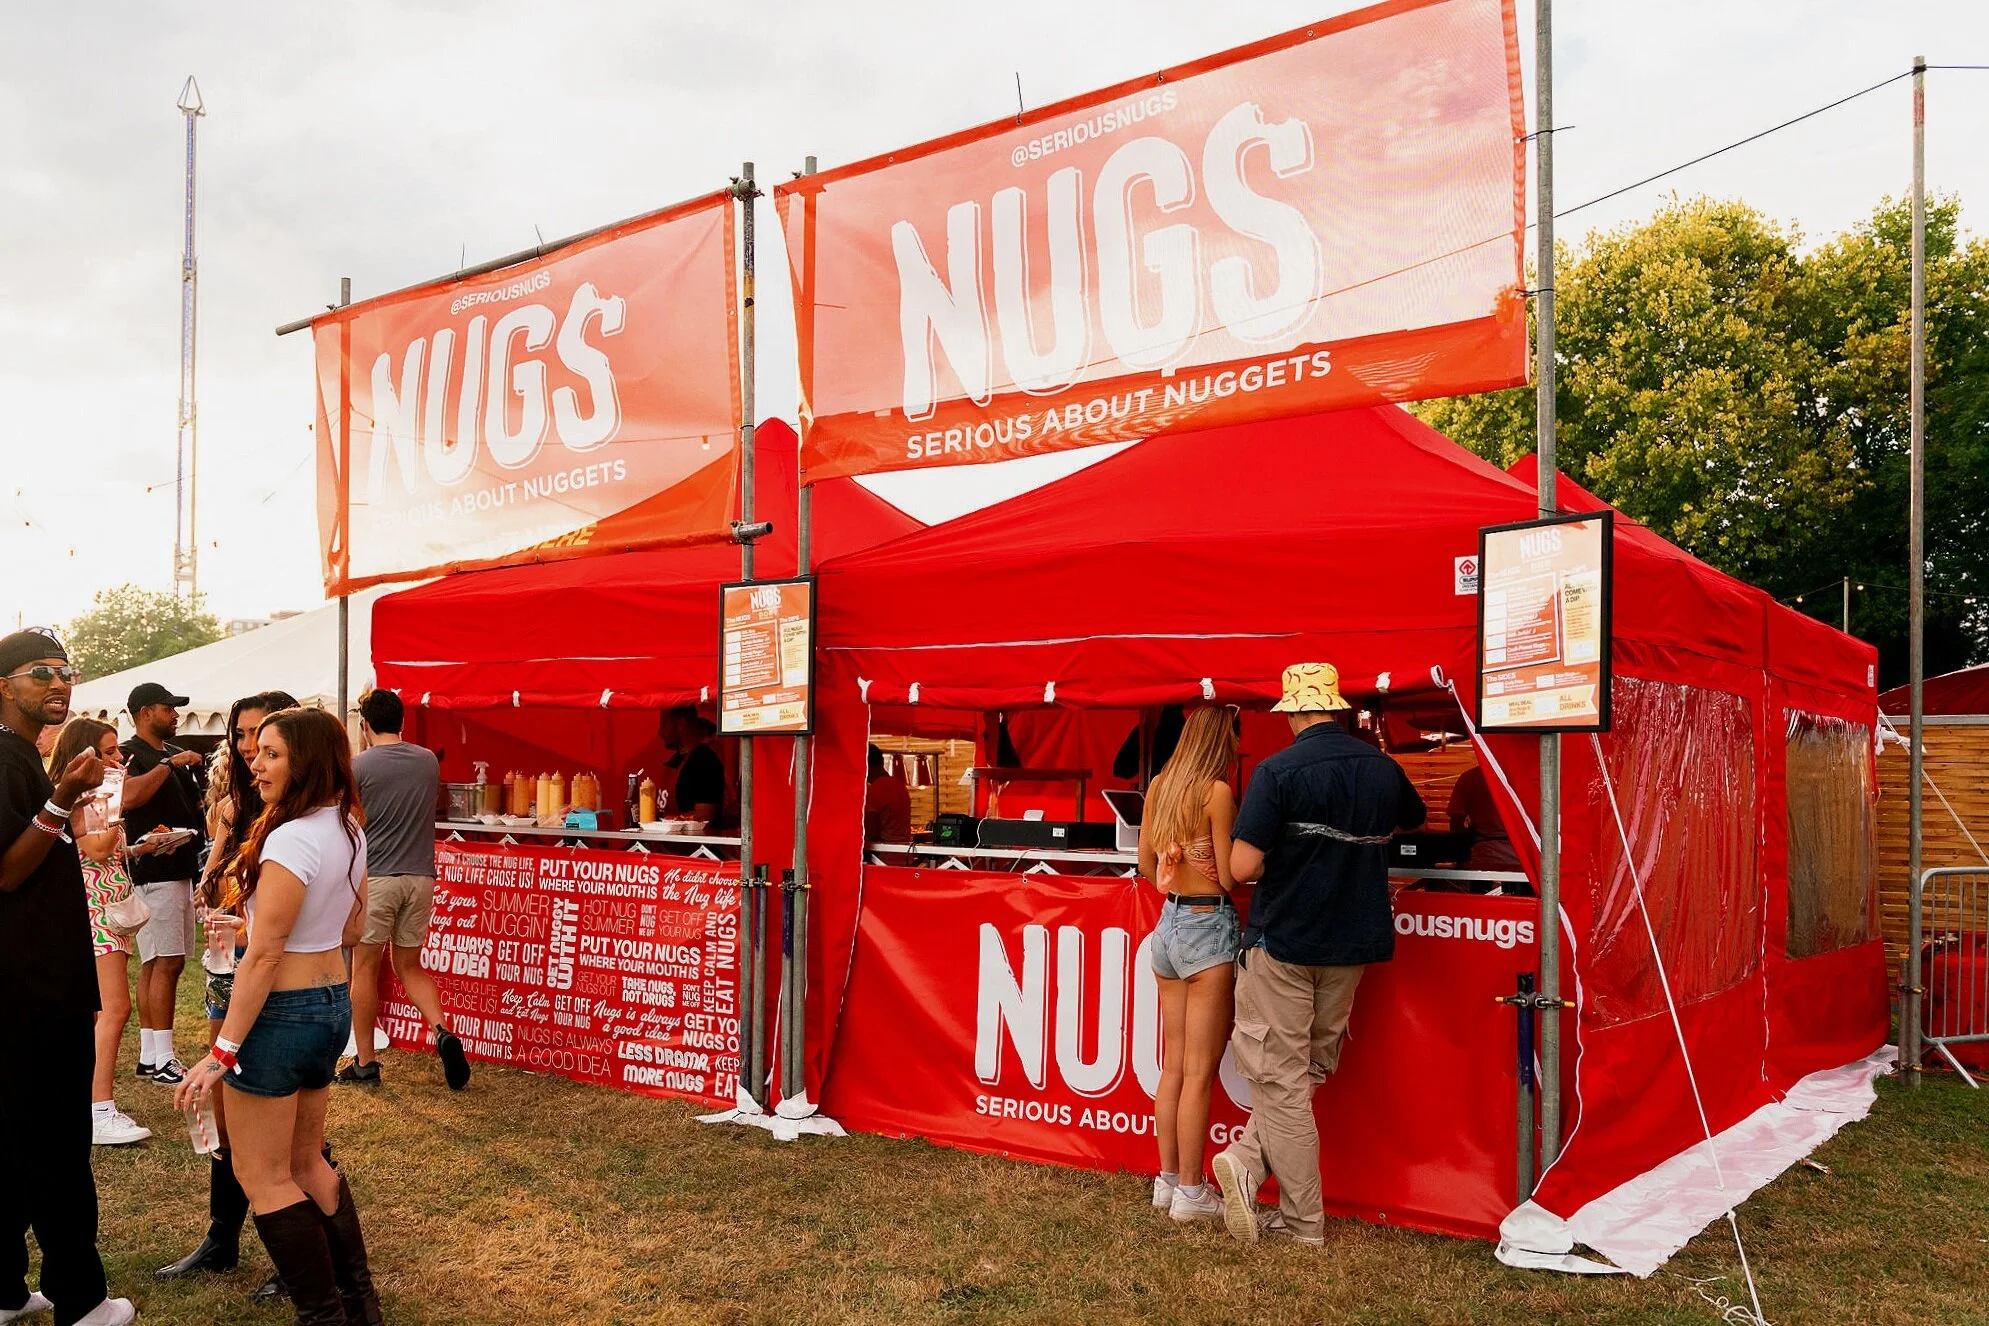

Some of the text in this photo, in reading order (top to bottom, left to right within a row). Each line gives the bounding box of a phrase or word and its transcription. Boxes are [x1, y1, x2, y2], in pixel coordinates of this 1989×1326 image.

[1011, 90, 1177, 168] @SERIOUSNUGS
[891, 101, 1324, 423] NUGS
[450, 271, 550, 315] @SERIOUSNUGS
[366, 281, 626, 507] NUGS
[906, 349, 1333, 460] SERIOUS ABOUT NUGGETS
[450, 484, 517, 520] ABOUT
[522, 459, 627, 500] NUGGETS
[1519, 527, 1562, 560] NUGS
[749, 587, 782, 610] NUGS
[1560, 701, 1586, 711] DRINKS
[462, 853, 488, 867] CHOOSE
[490, 855, 502, 868] THE
[504, 857, 518, 870] NUG
[540, 858, 660, 884] PUT YOUR NUGS
[444, 866, 462, 882] NUG
[465, 866, 484, 884] LIFE
[486, 868, 516, 887] CHOSE
[518, 872, 534, 888] US!
[539, 877, 658, 900] WHERE YOUR MOUTH IS
[708, 871, 738, 886] choose
[447, 894, 478, 912] your
[482, 890, 550, 916] SUMMER
[583, 899, 636, 918] HOT NUG
[662, 883, 736, 910] the Nug life
[456, 914, 478, 930] out
[562, 898, 580, 922] IT
[640, 914, 656, 928] NUG
[660, 910, 704, 926] GET OFF
[480, 911, 548, 940] NUGGIN'
[582, 915, 635, 935] SUMMER
[658, 924, 702, 940] YOUR NUG
[1391, 905, 1534, 949] ousnugs
[428, 932, 494, 956] IS ALWAYS
[497, 940, 546, 966] GET OFF
[580, 934, 702, 966] PUT YOUR NUGS
[716, 913, 737, 970] NUGS
[420, 947, 490, 979] OOD IDEA
[546, 955, 560, 988] GET
[580, 954, 700, 980] WHERE YOUR MOUTH IS
[703, 911, 718, 1012] KEEP CALM AND
[495, 962, 544, 986] YOUR NUG
[577, 970, 617, 986] GET YOUR
[622, 976, 646, 992] TAKE
[444, 977, 460, 990] THE
[460, 980, 478, 994] NUG
[480, 984, 498, 997] LIFE
[502, 988, 550, 1008] Keep Calm
[576, 982, 617, 996] NUGS OUT
[622, 989, 675, 1008] NOT DRUGS
[682, 984, 700, 992] DON'T
[682, 992, 700, 1002] NUG
[716, 976, 734, 1014] EAT
[440, 990, 498, 1014] CHOSE US!
[554, 994, 592, 1014] GET OFF
[500, 1006, 550, 1024] and Eat Nugs
[553, 1011, 591, 1030] YOUR NUG
[594, 1000, 680, 1031] Nugs is always
[684, 1012, 740, 1036] GET YO
[406, 1021, 422, 1042] IT
[452, 1014, 480, 1038] YOUR
[483, 1020, 514, 1044] NUGS
[518, 1025, 614, 1054] NUGS IS ALWAYS
[602, 1022, 671, 1041] a good idea
[682, 1030, 725, 1050] NUGS
[474, 1040, 502, 1058] MOUTH
[504, 1046, 513, 1060] IS
[516, 1044, 612, 1078] A GOOD IDEA
[618, 1041, 652, 1062] LESS
[715, 1056, 740, 1072] KEEP
[624, 1064, 705, 1093] MORE NUGS
[975, 1095, 1072, 1126] SERIOUS
